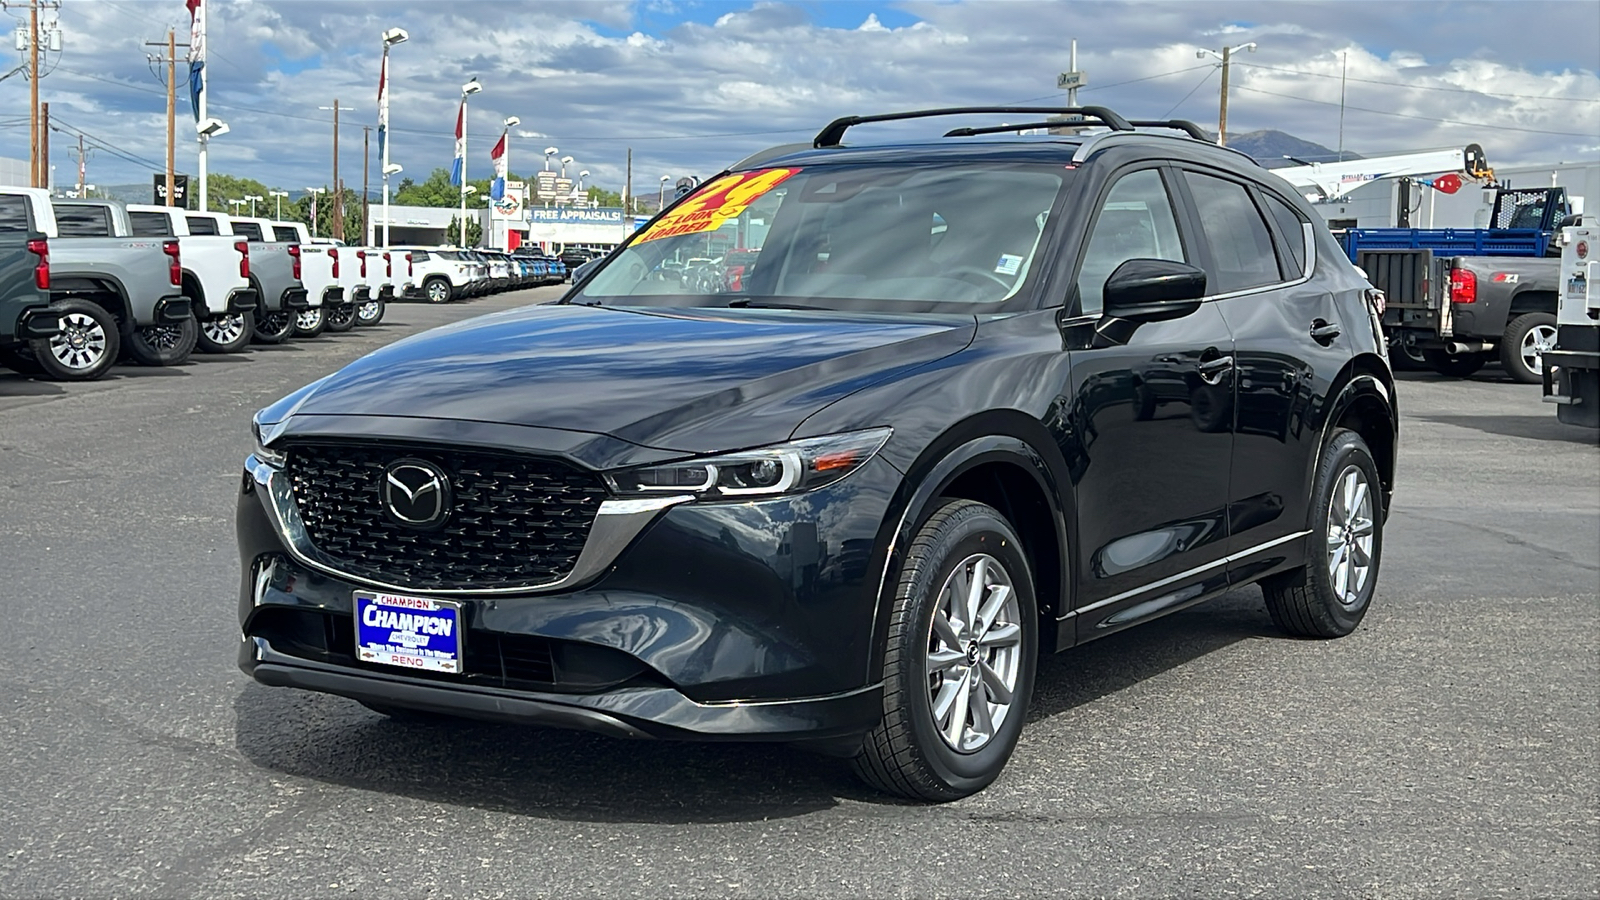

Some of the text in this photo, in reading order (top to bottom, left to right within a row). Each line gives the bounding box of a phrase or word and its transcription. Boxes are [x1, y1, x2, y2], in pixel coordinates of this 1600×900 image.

[534, 210, 558, 220] FREE
[560, 210, 621, 221] APPRAISALS!
[674, 209, 718, 224] LOOK
[640, 220, 713, 243] LOADED
[381, 596, 430, 609] CHAMPION
[363, 604, 453, 637] CHAMPION
[391, 633, 427, 644] CHEVROLET
[391, 655, 423, 667] RENO
